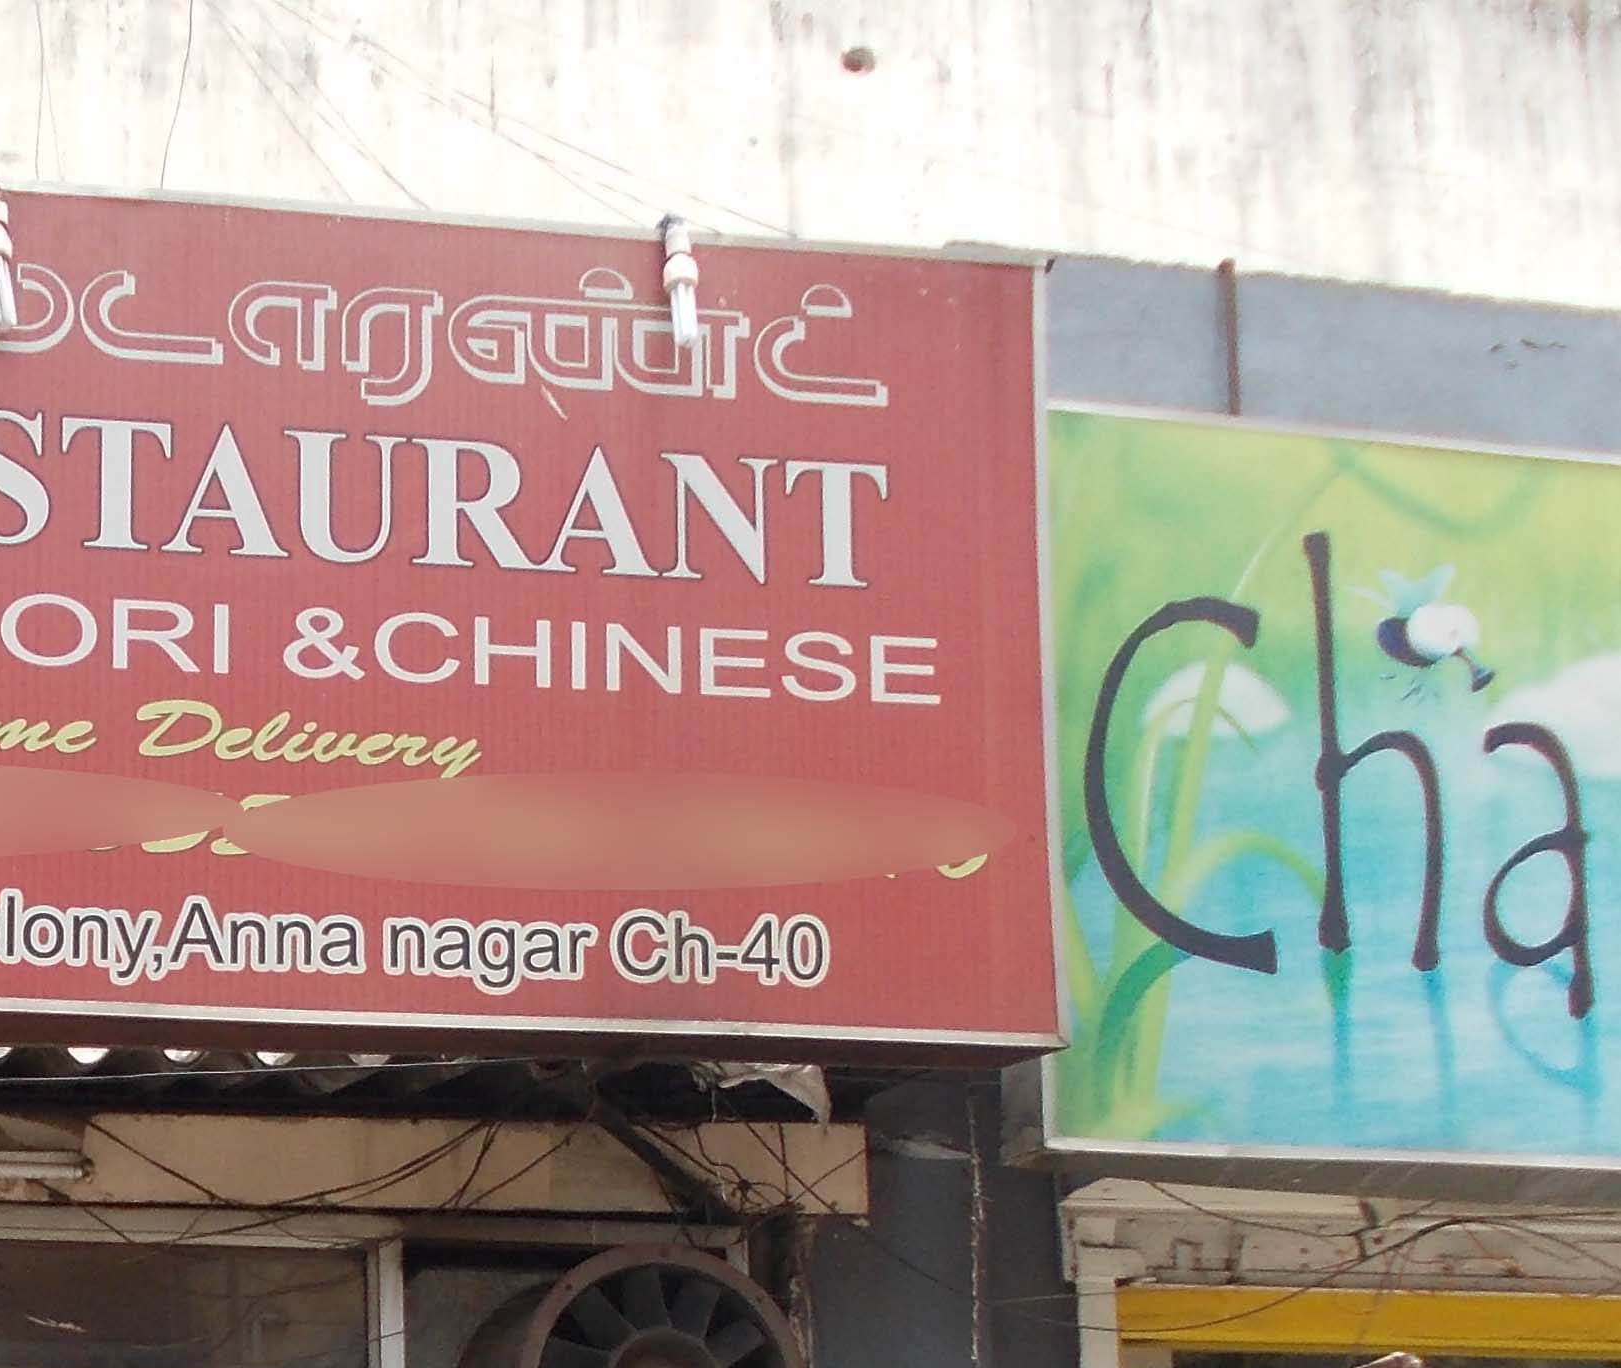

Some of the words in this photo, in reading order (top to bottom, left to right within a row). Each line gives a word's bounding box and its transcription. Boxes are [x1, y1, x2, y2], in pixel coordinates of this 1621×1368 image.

[135, 699, 481, 778] Delivery
[382, 915, 593, 995] nagar
[611, 909, 830, 987] Ch-40
